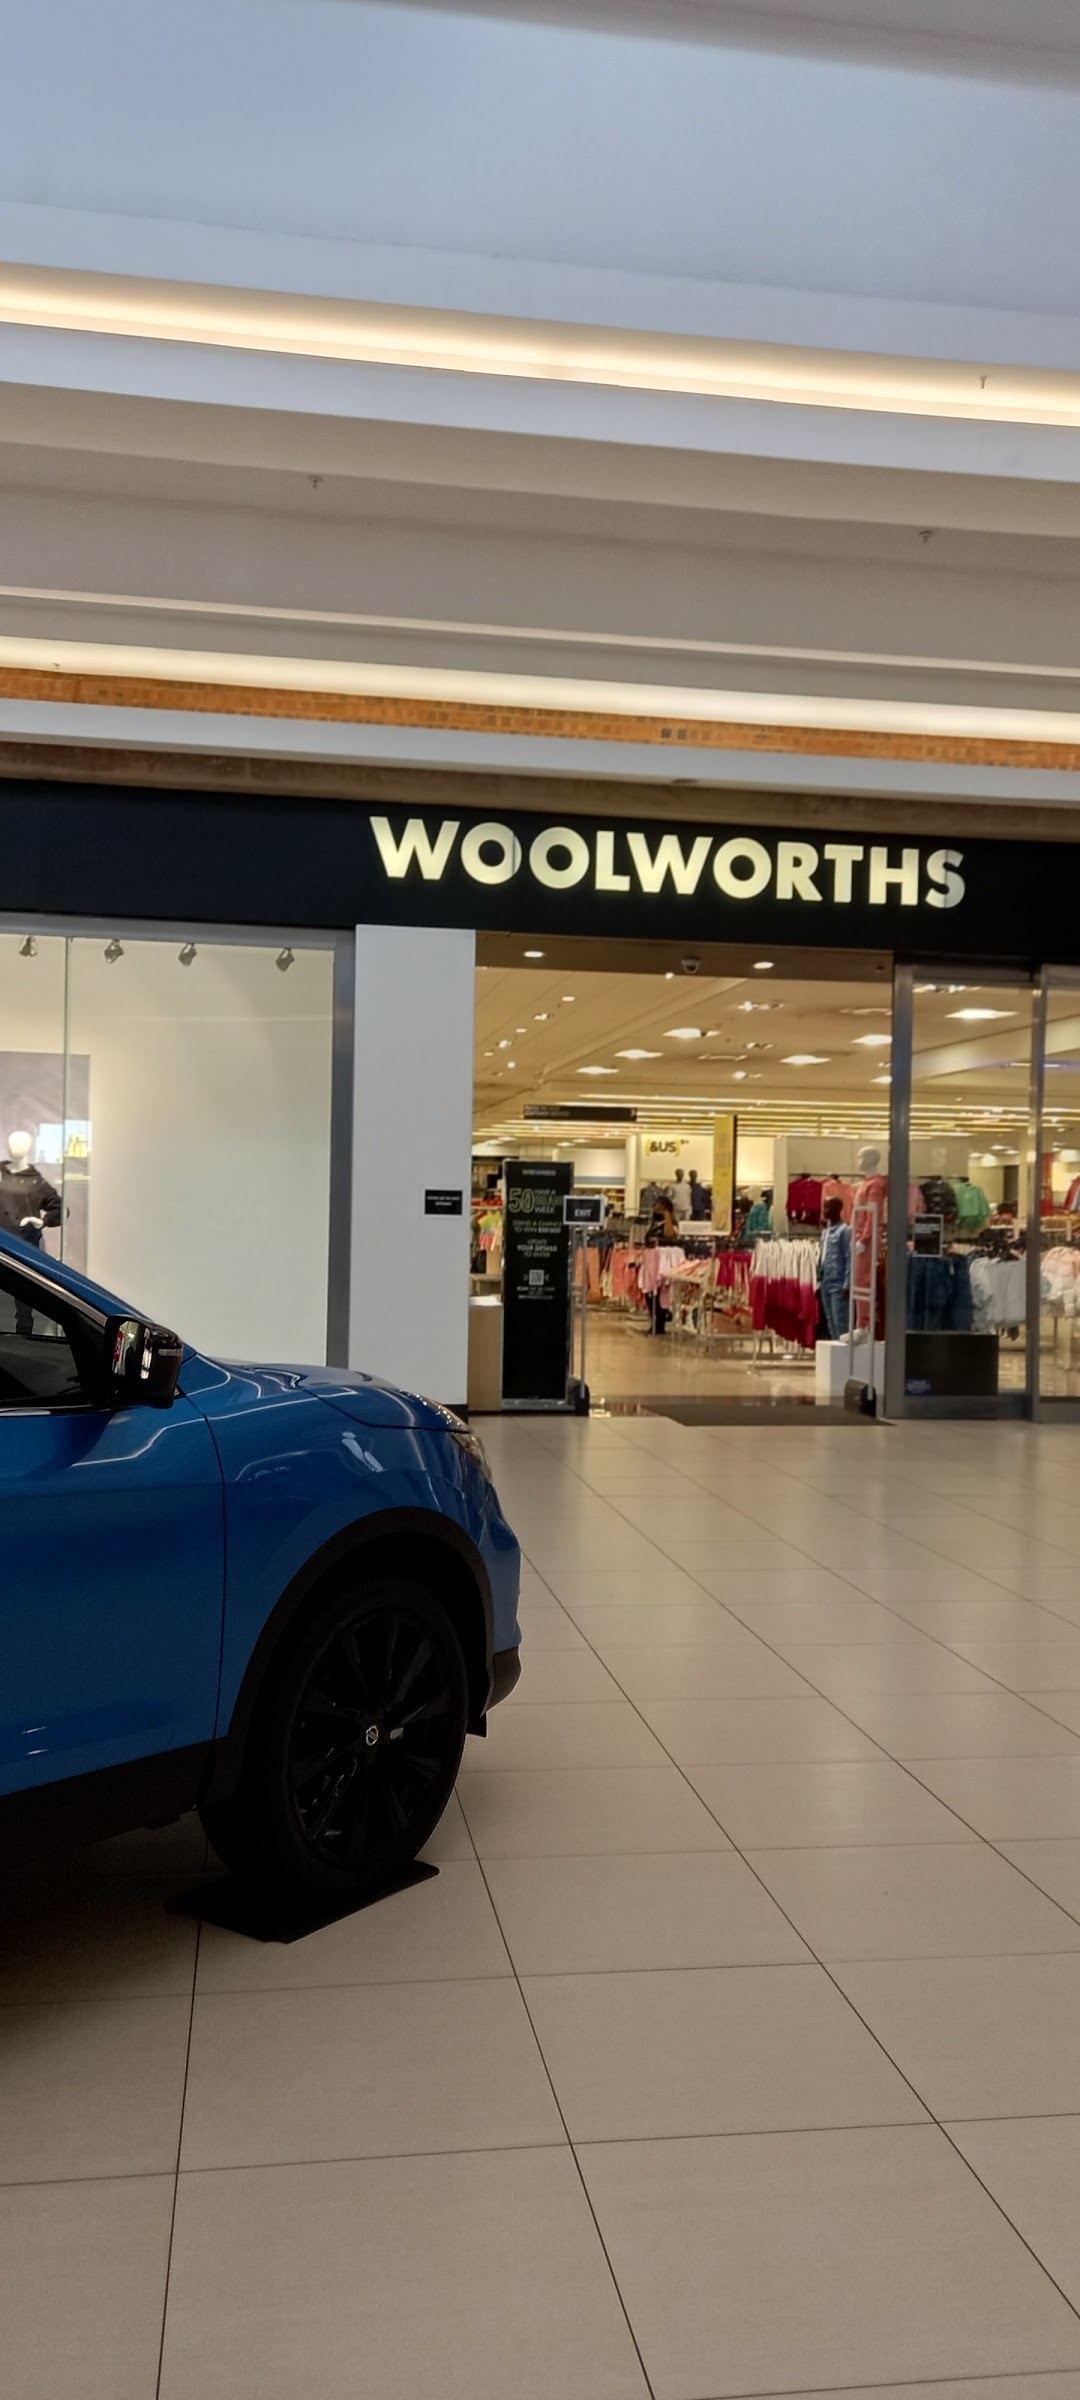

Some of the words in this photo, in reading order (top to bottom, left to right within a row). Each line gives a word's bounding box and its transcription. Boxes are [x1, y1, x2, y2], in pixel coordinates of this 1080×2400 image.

[369, 816, 965, 908] WOOLWORTHS
[508, 1187, 535, 1213] 50
[574, 1209, 592, 1217] EXIT
